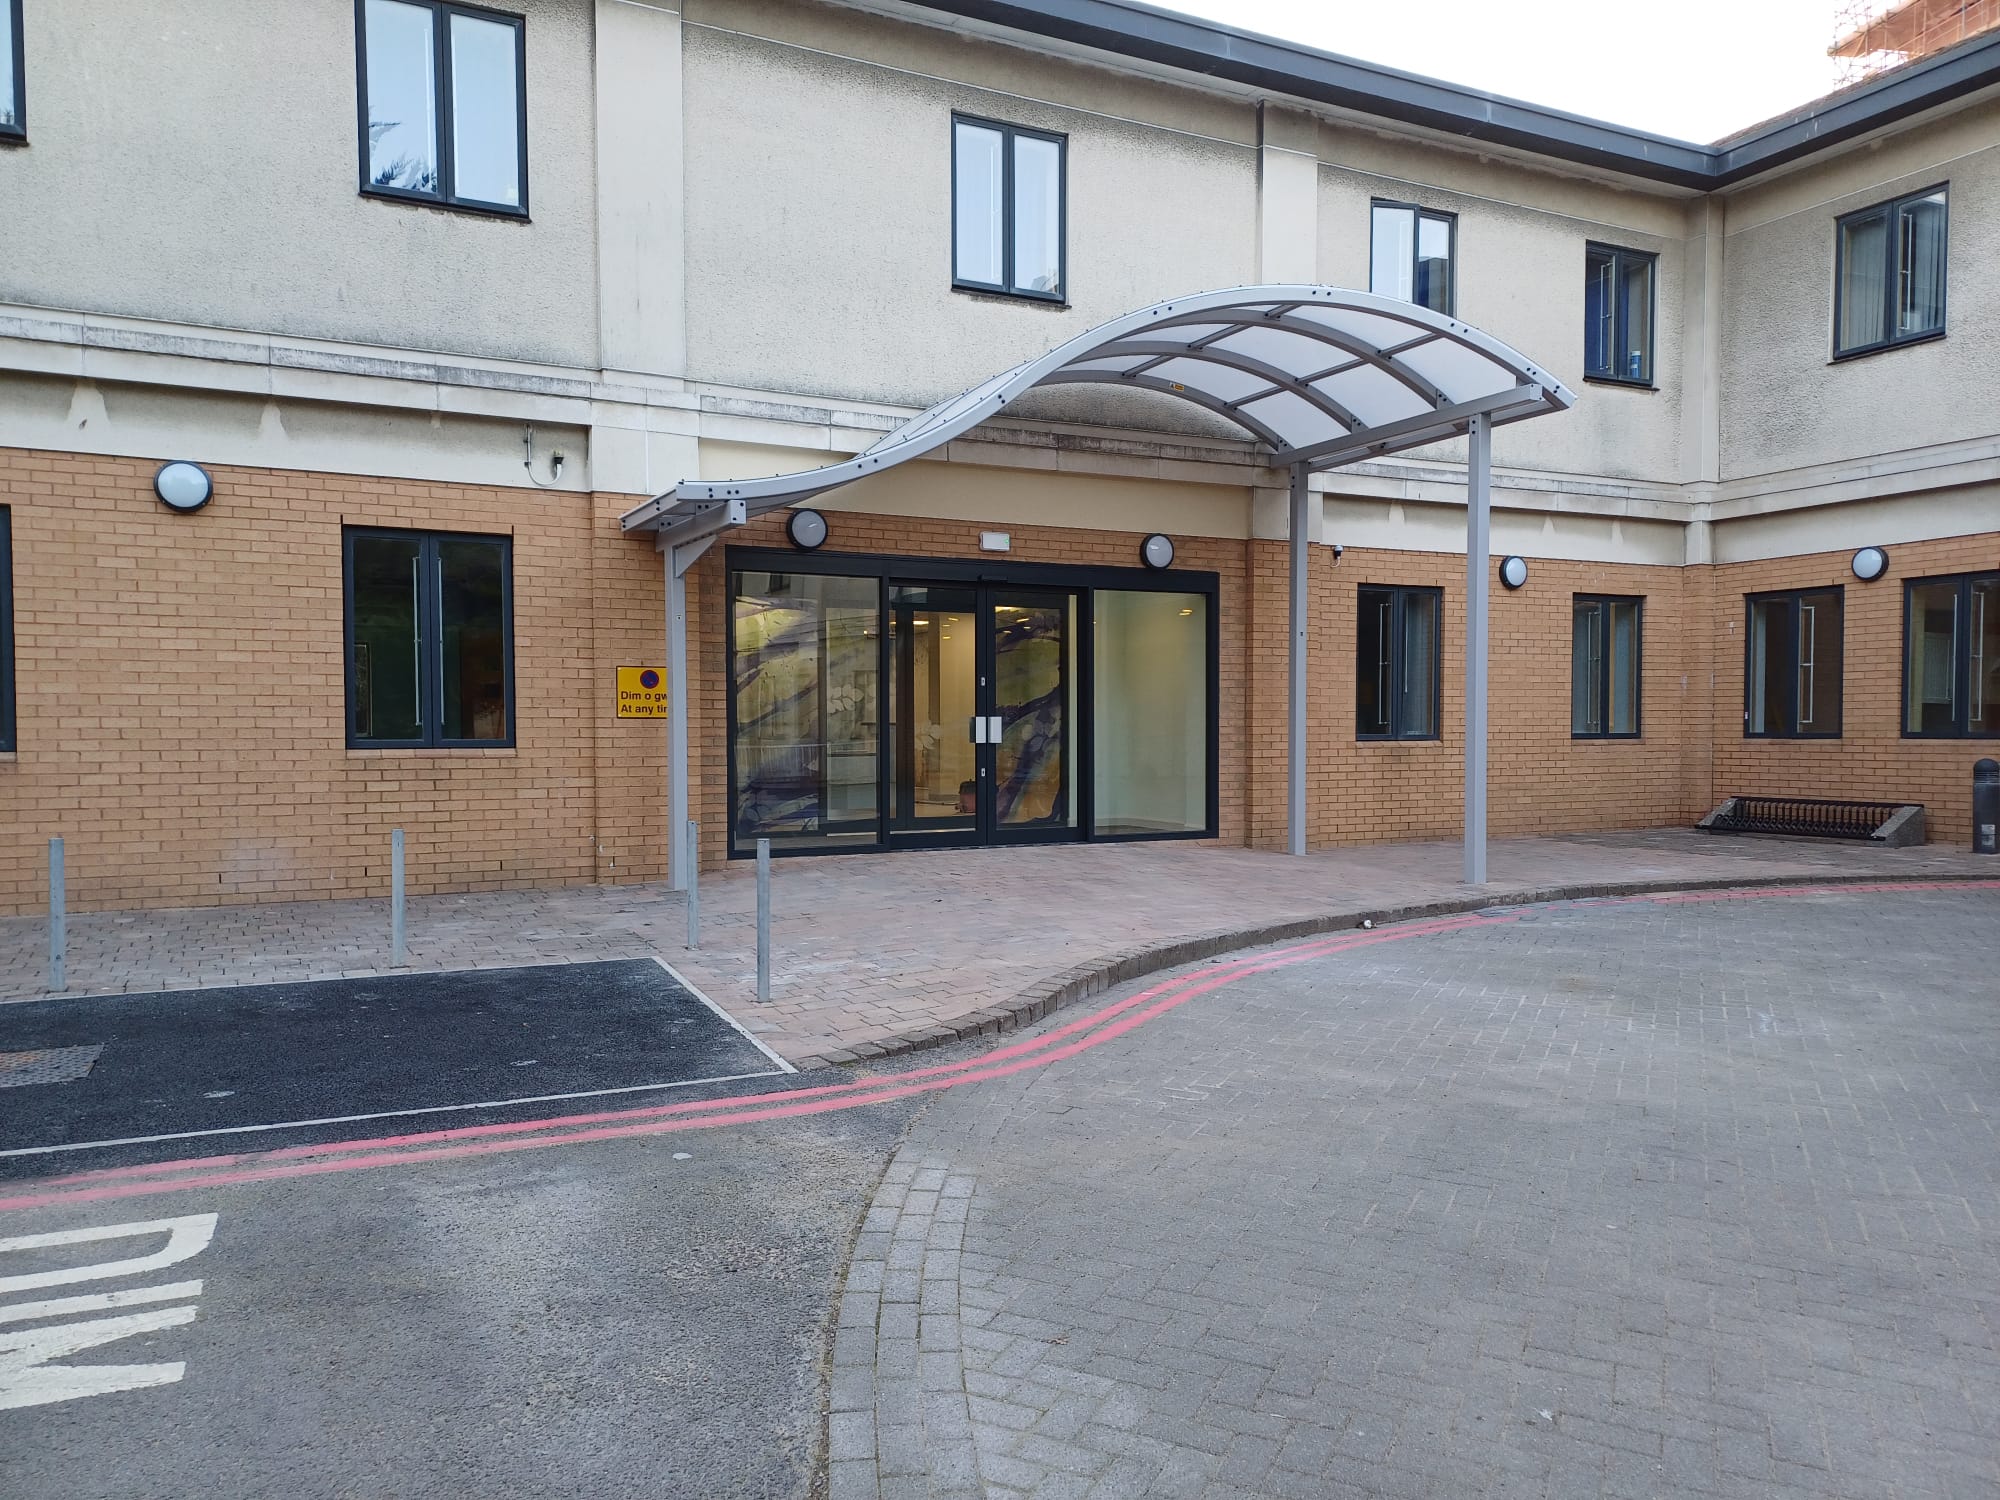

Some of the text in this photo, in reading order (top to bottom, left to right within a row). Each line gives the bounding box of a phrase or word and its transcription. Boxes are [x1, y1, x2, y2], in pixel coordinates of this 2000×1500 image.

[621, 691, 641, 700] Dim
[621, 704, 632, 713] At
[635, 706, 653, 715] any
